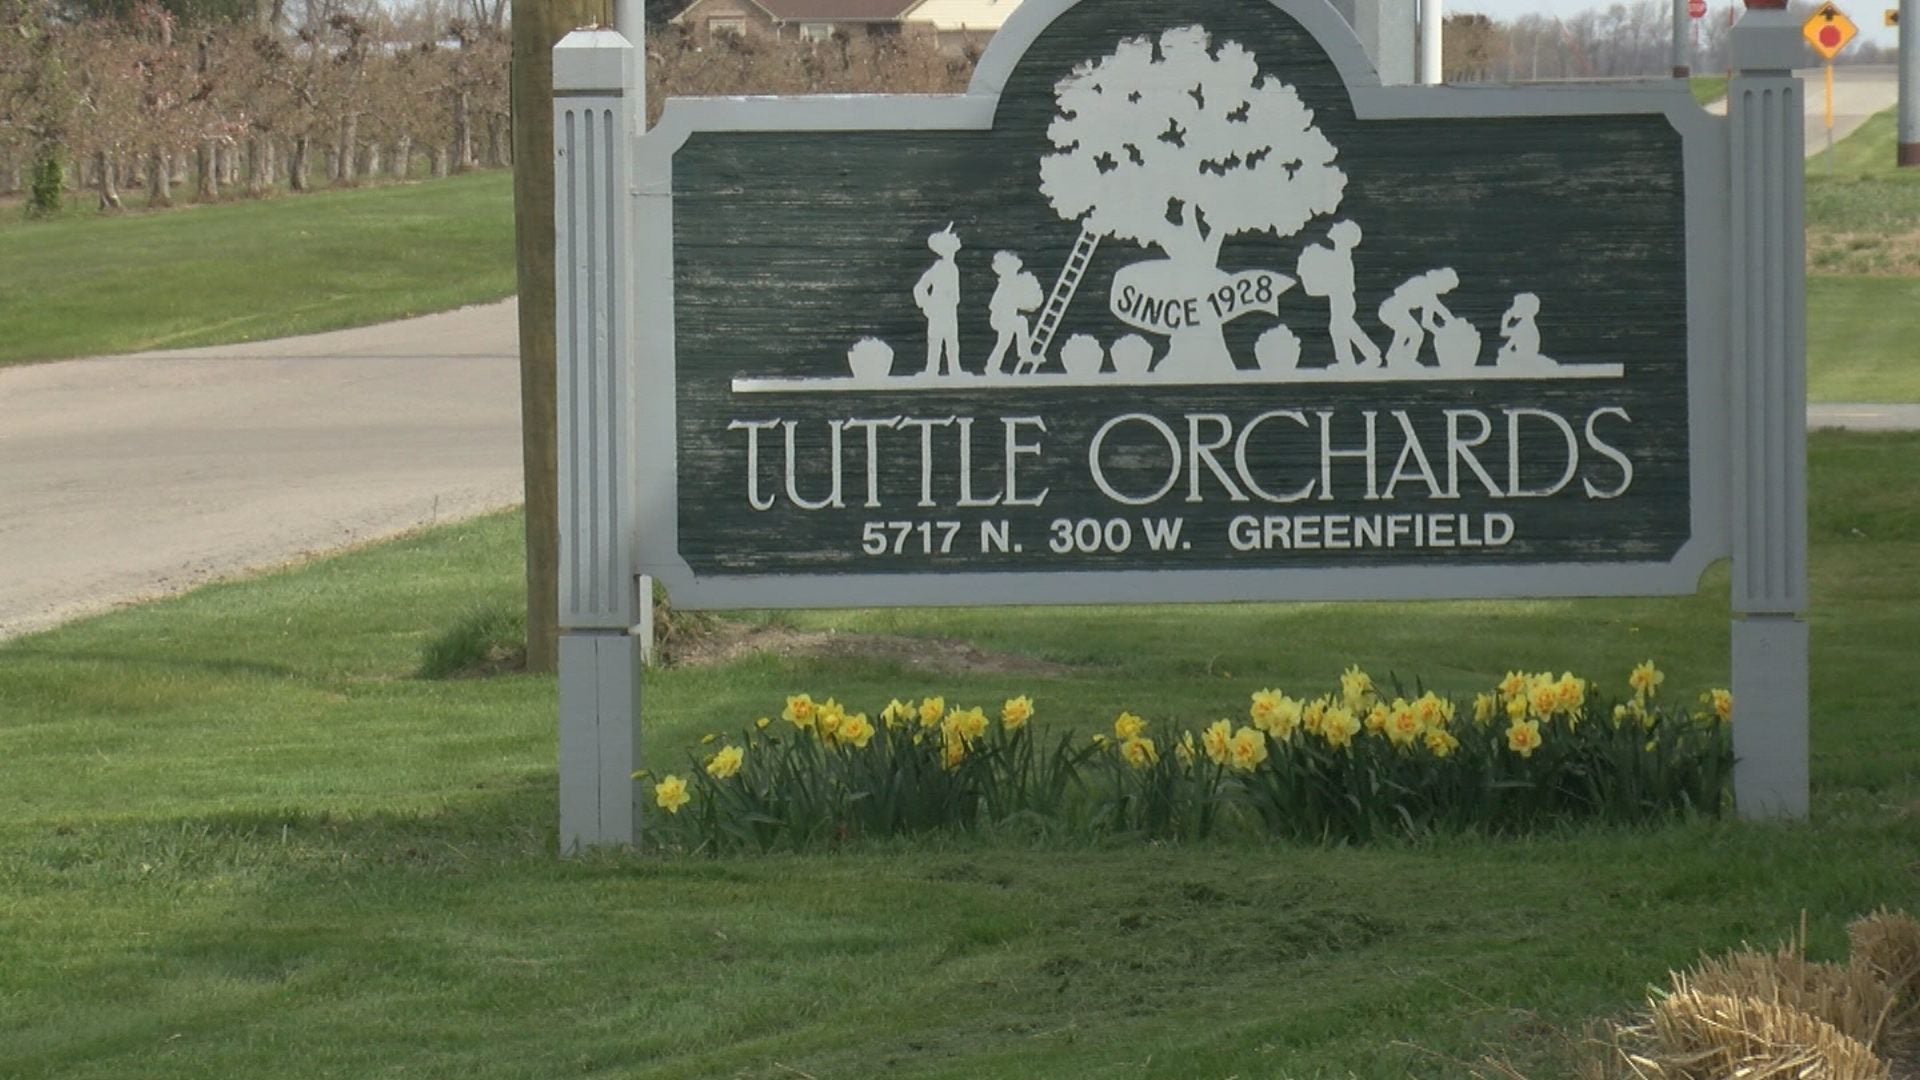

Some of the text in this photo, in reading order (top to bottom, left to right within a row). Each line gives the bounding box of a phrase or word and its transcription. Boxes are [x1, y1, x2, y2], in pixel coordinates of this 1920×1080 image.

[1118, 275, 1272, 328] SINCE 1928
[727, 407, 1633, 510] TUTTLE ORCHARDS
[862, 513, 1515, 555] 5717 N. 300 W. GREENFIELD
